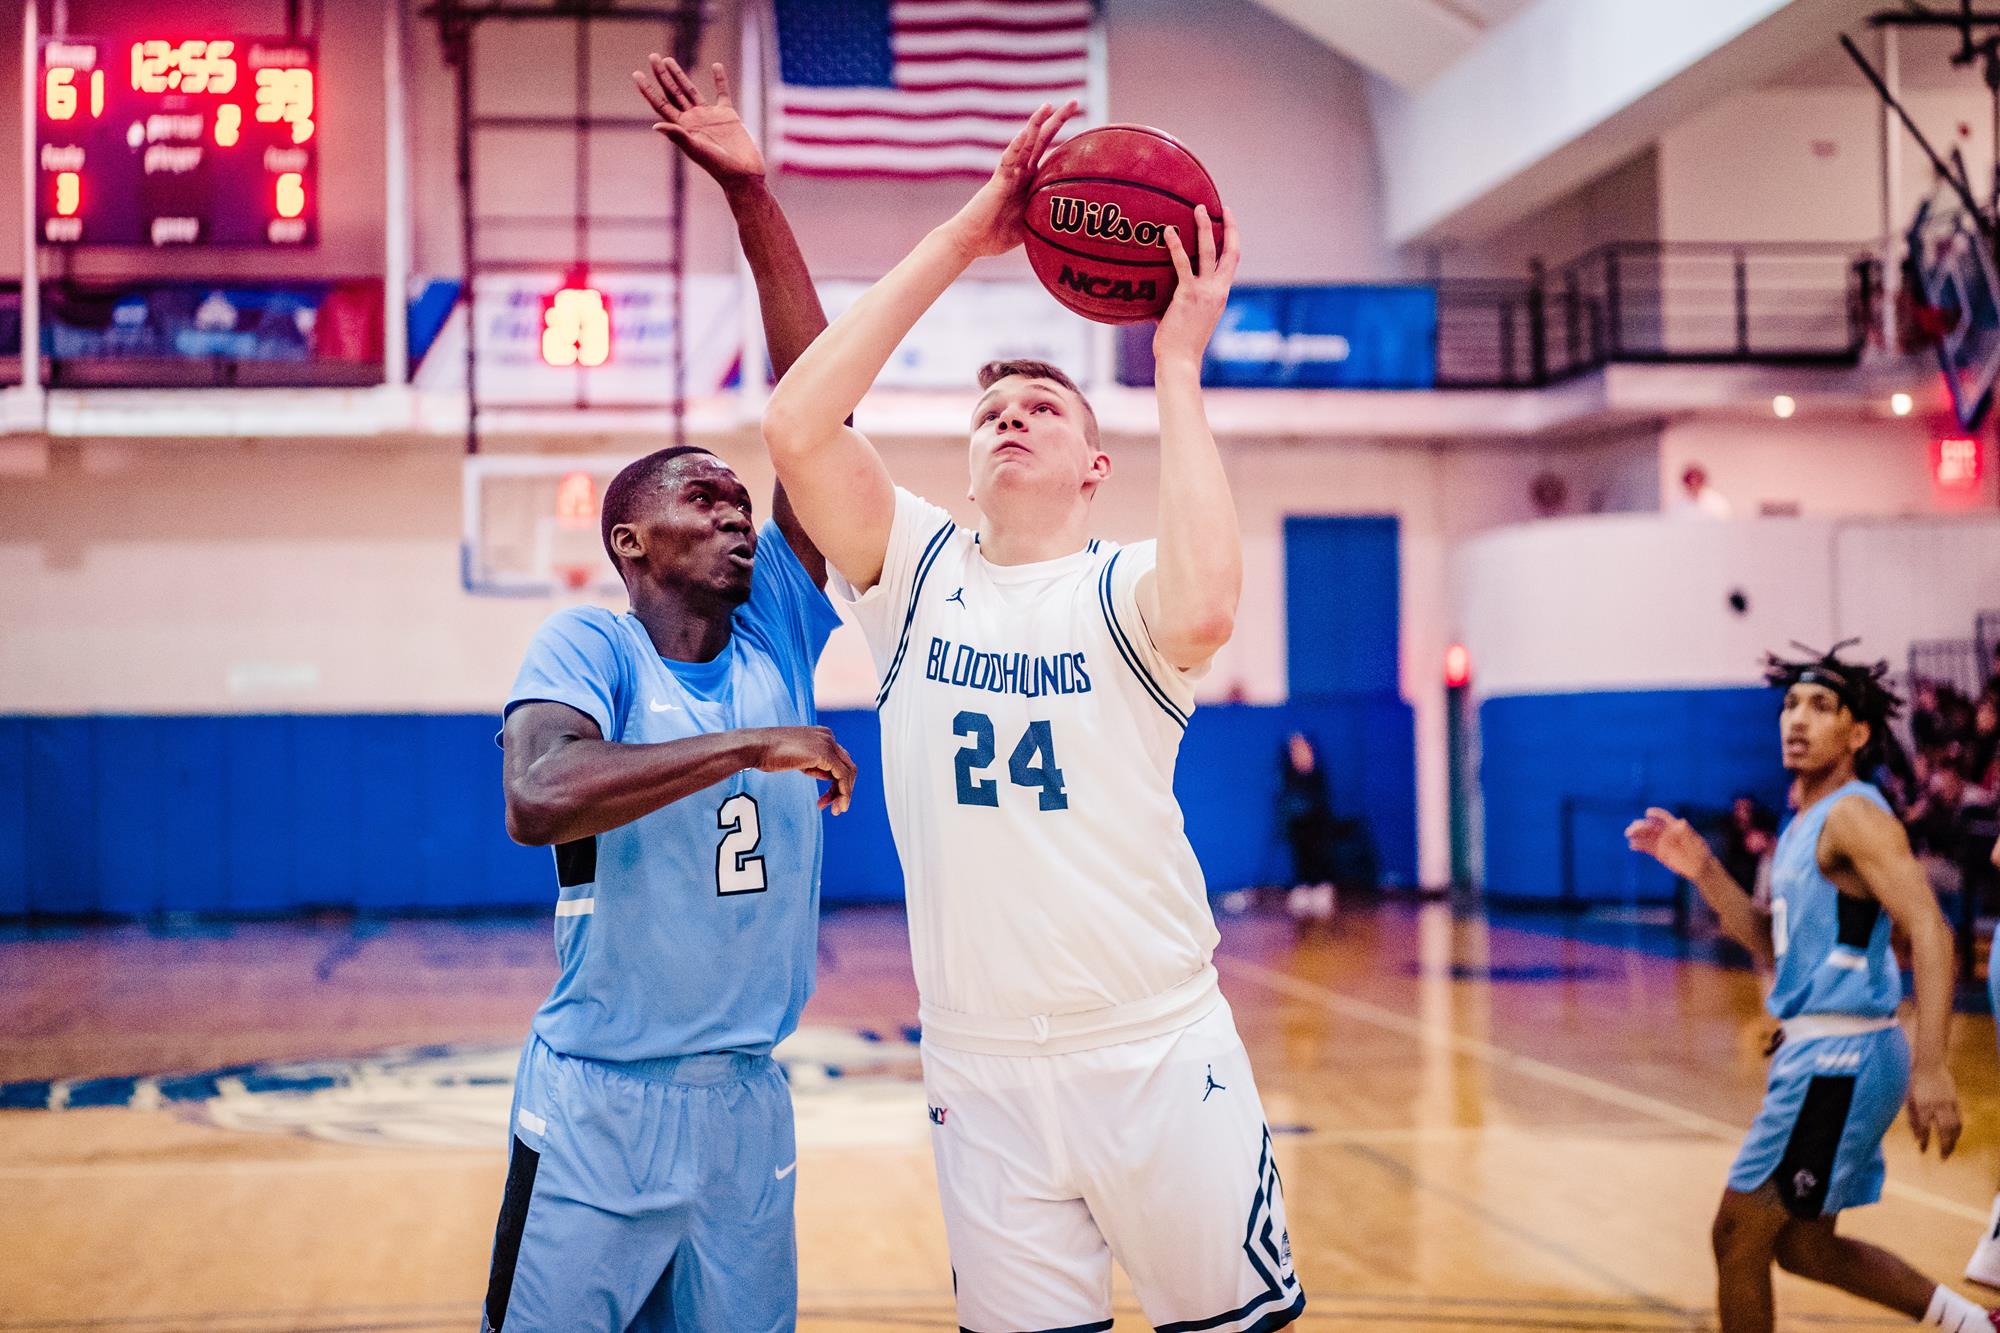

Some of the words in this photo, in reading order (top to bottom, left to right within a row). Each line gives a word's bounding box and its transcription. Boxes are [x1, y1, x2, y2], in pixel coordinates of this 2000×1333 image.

[131, 40, 237, 93] 12:55
[46, 67, 104, 120] 61
[1058, 264, 1157, 302] NCAA
[952, 710, 1069, 812] 24
[715, 792, 768, 897] 2
